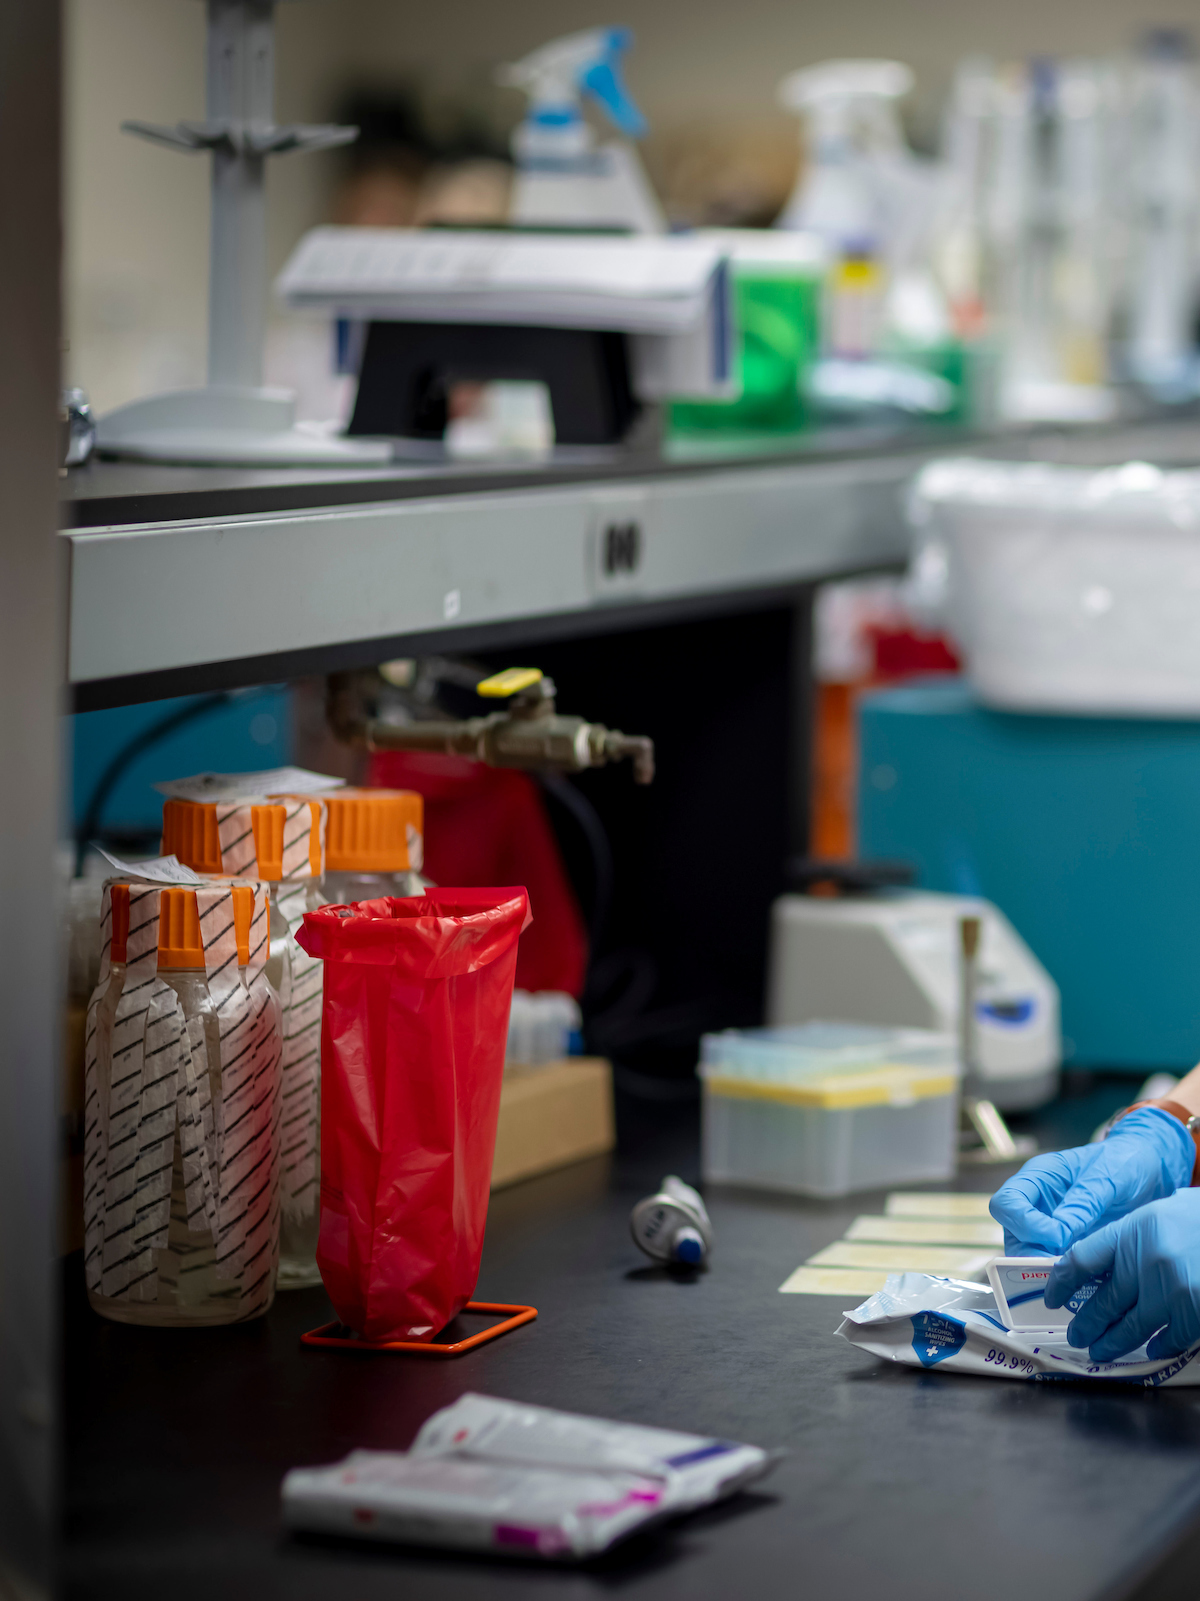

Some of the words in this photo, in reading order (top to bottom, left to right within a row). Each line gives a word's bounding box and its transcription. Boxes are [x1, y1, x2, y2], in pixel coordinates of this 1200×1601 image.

[924, 1331, 956, 1344] SANITIZING
[928, 1326, 953, 1337] ALCOHOL
[984, 1348, 1034, 1374] 99.9%
